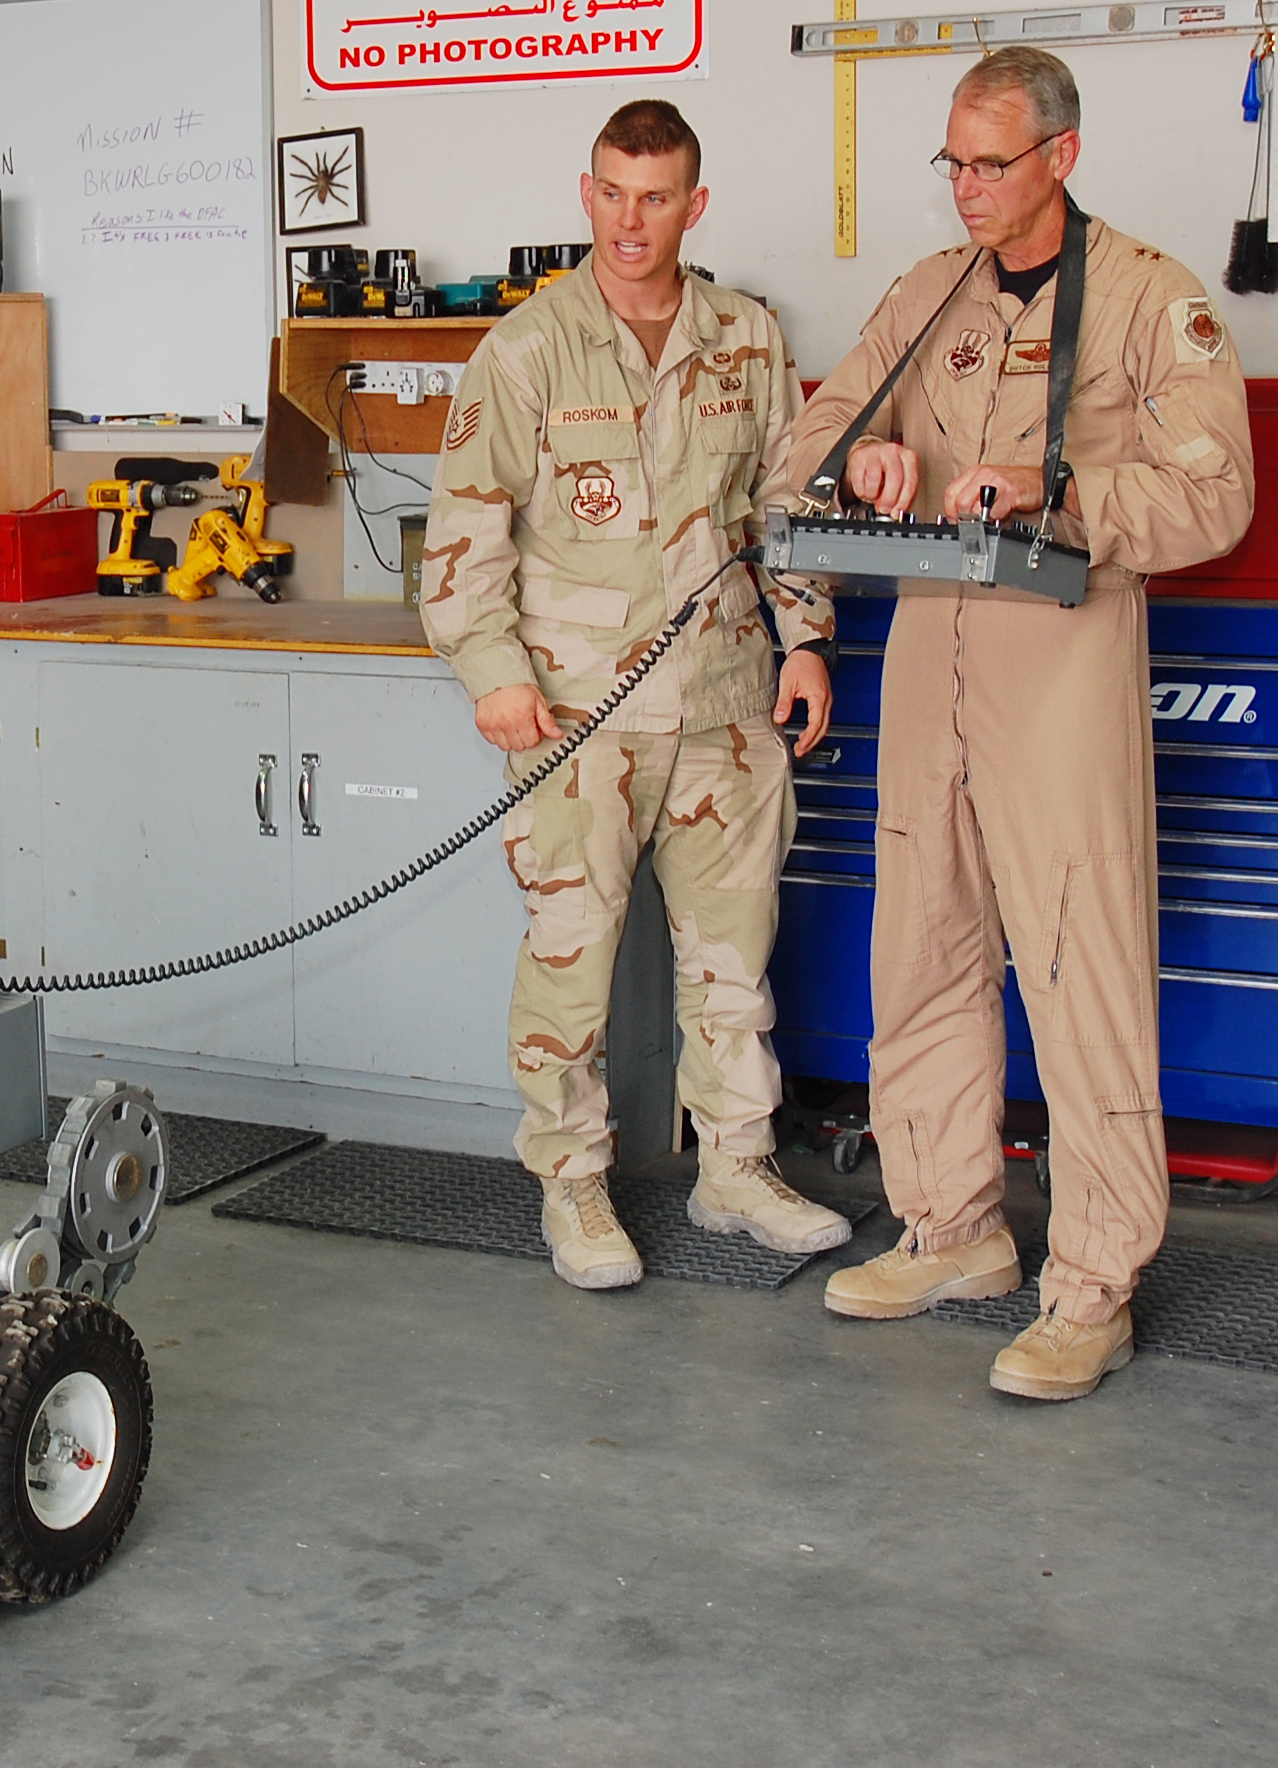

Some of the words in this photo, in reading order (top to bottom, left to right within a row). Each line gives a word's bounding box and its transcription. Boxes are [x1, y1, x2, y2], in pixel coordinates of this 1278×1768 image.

[339, 46, 385, 68] NO
[397, 28, 664, 65] PHOTOGRAPHY
[562, 408, 619, 424] ROSKOM
[698, 403, 720, 418] U.S.
[719, 400, 735, 415] AIR
[357, 785, 392, 796] CABINET
[395, 788, 405, 797] #2
